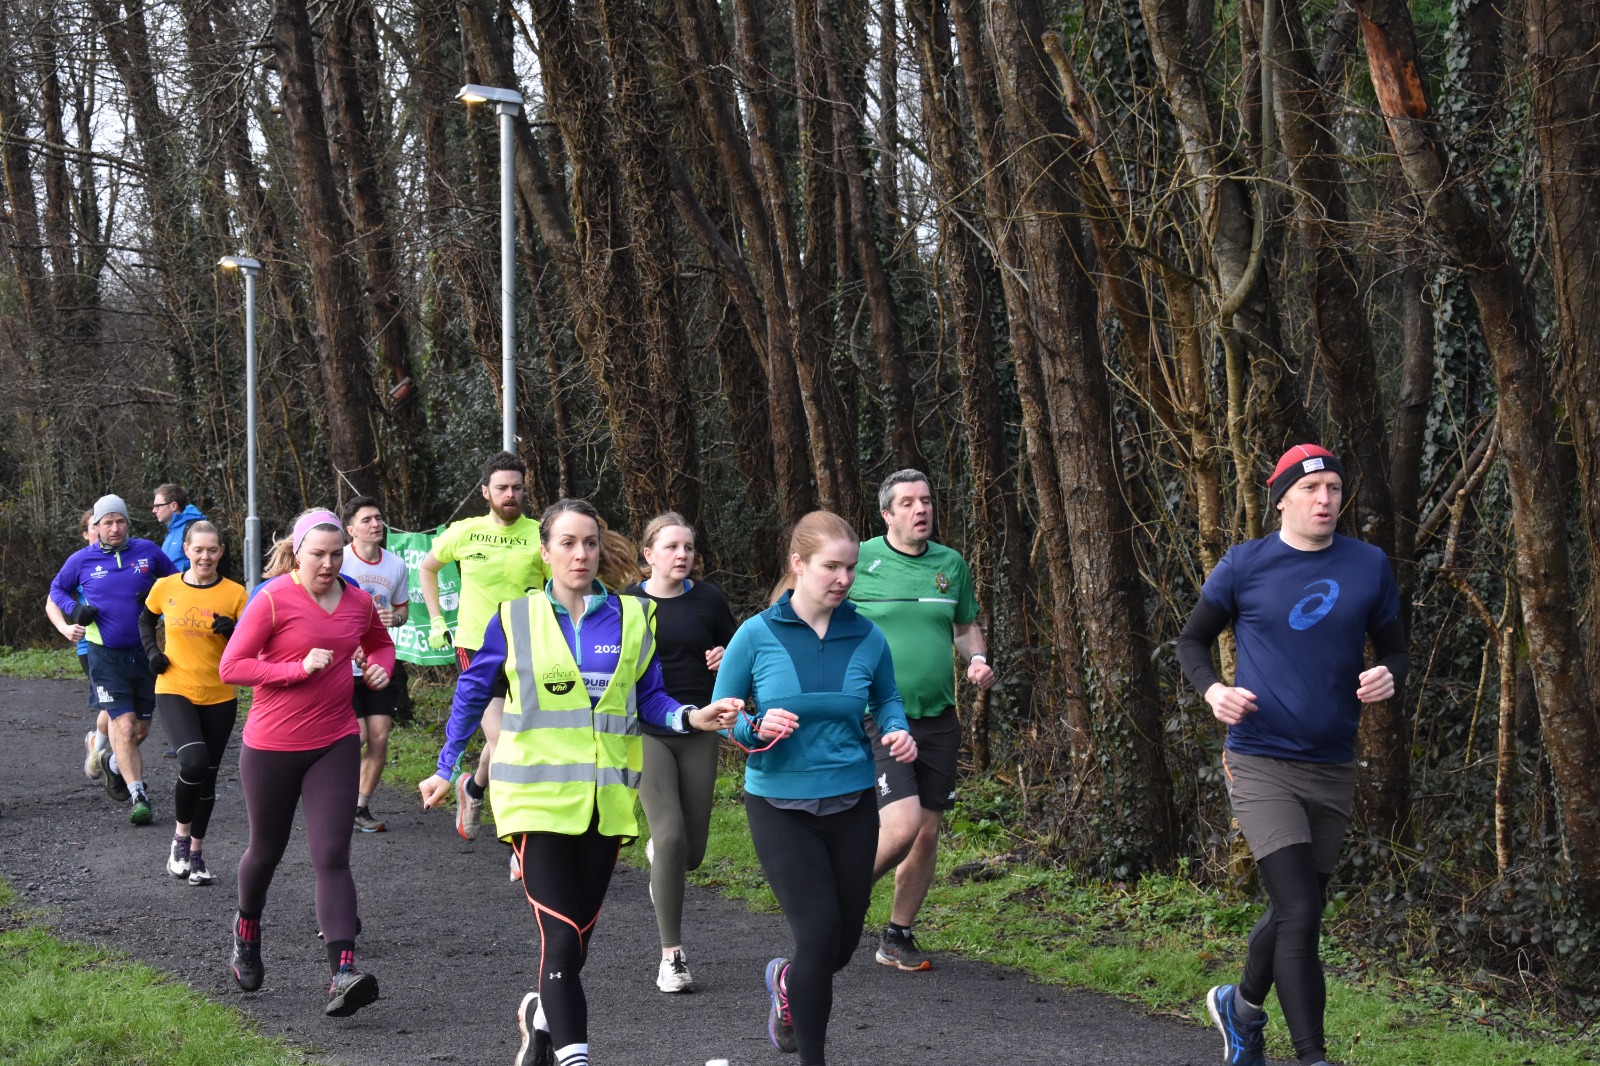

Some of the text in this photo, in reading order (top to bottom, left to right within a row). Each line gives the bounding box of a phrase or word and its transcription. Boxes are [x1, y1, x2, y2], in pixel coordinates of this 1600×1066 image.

[469, 533, 529, 546] PORTWEST
[169, 612, 213, 629] parkru
[542, 666, 576, 681] parkrun
